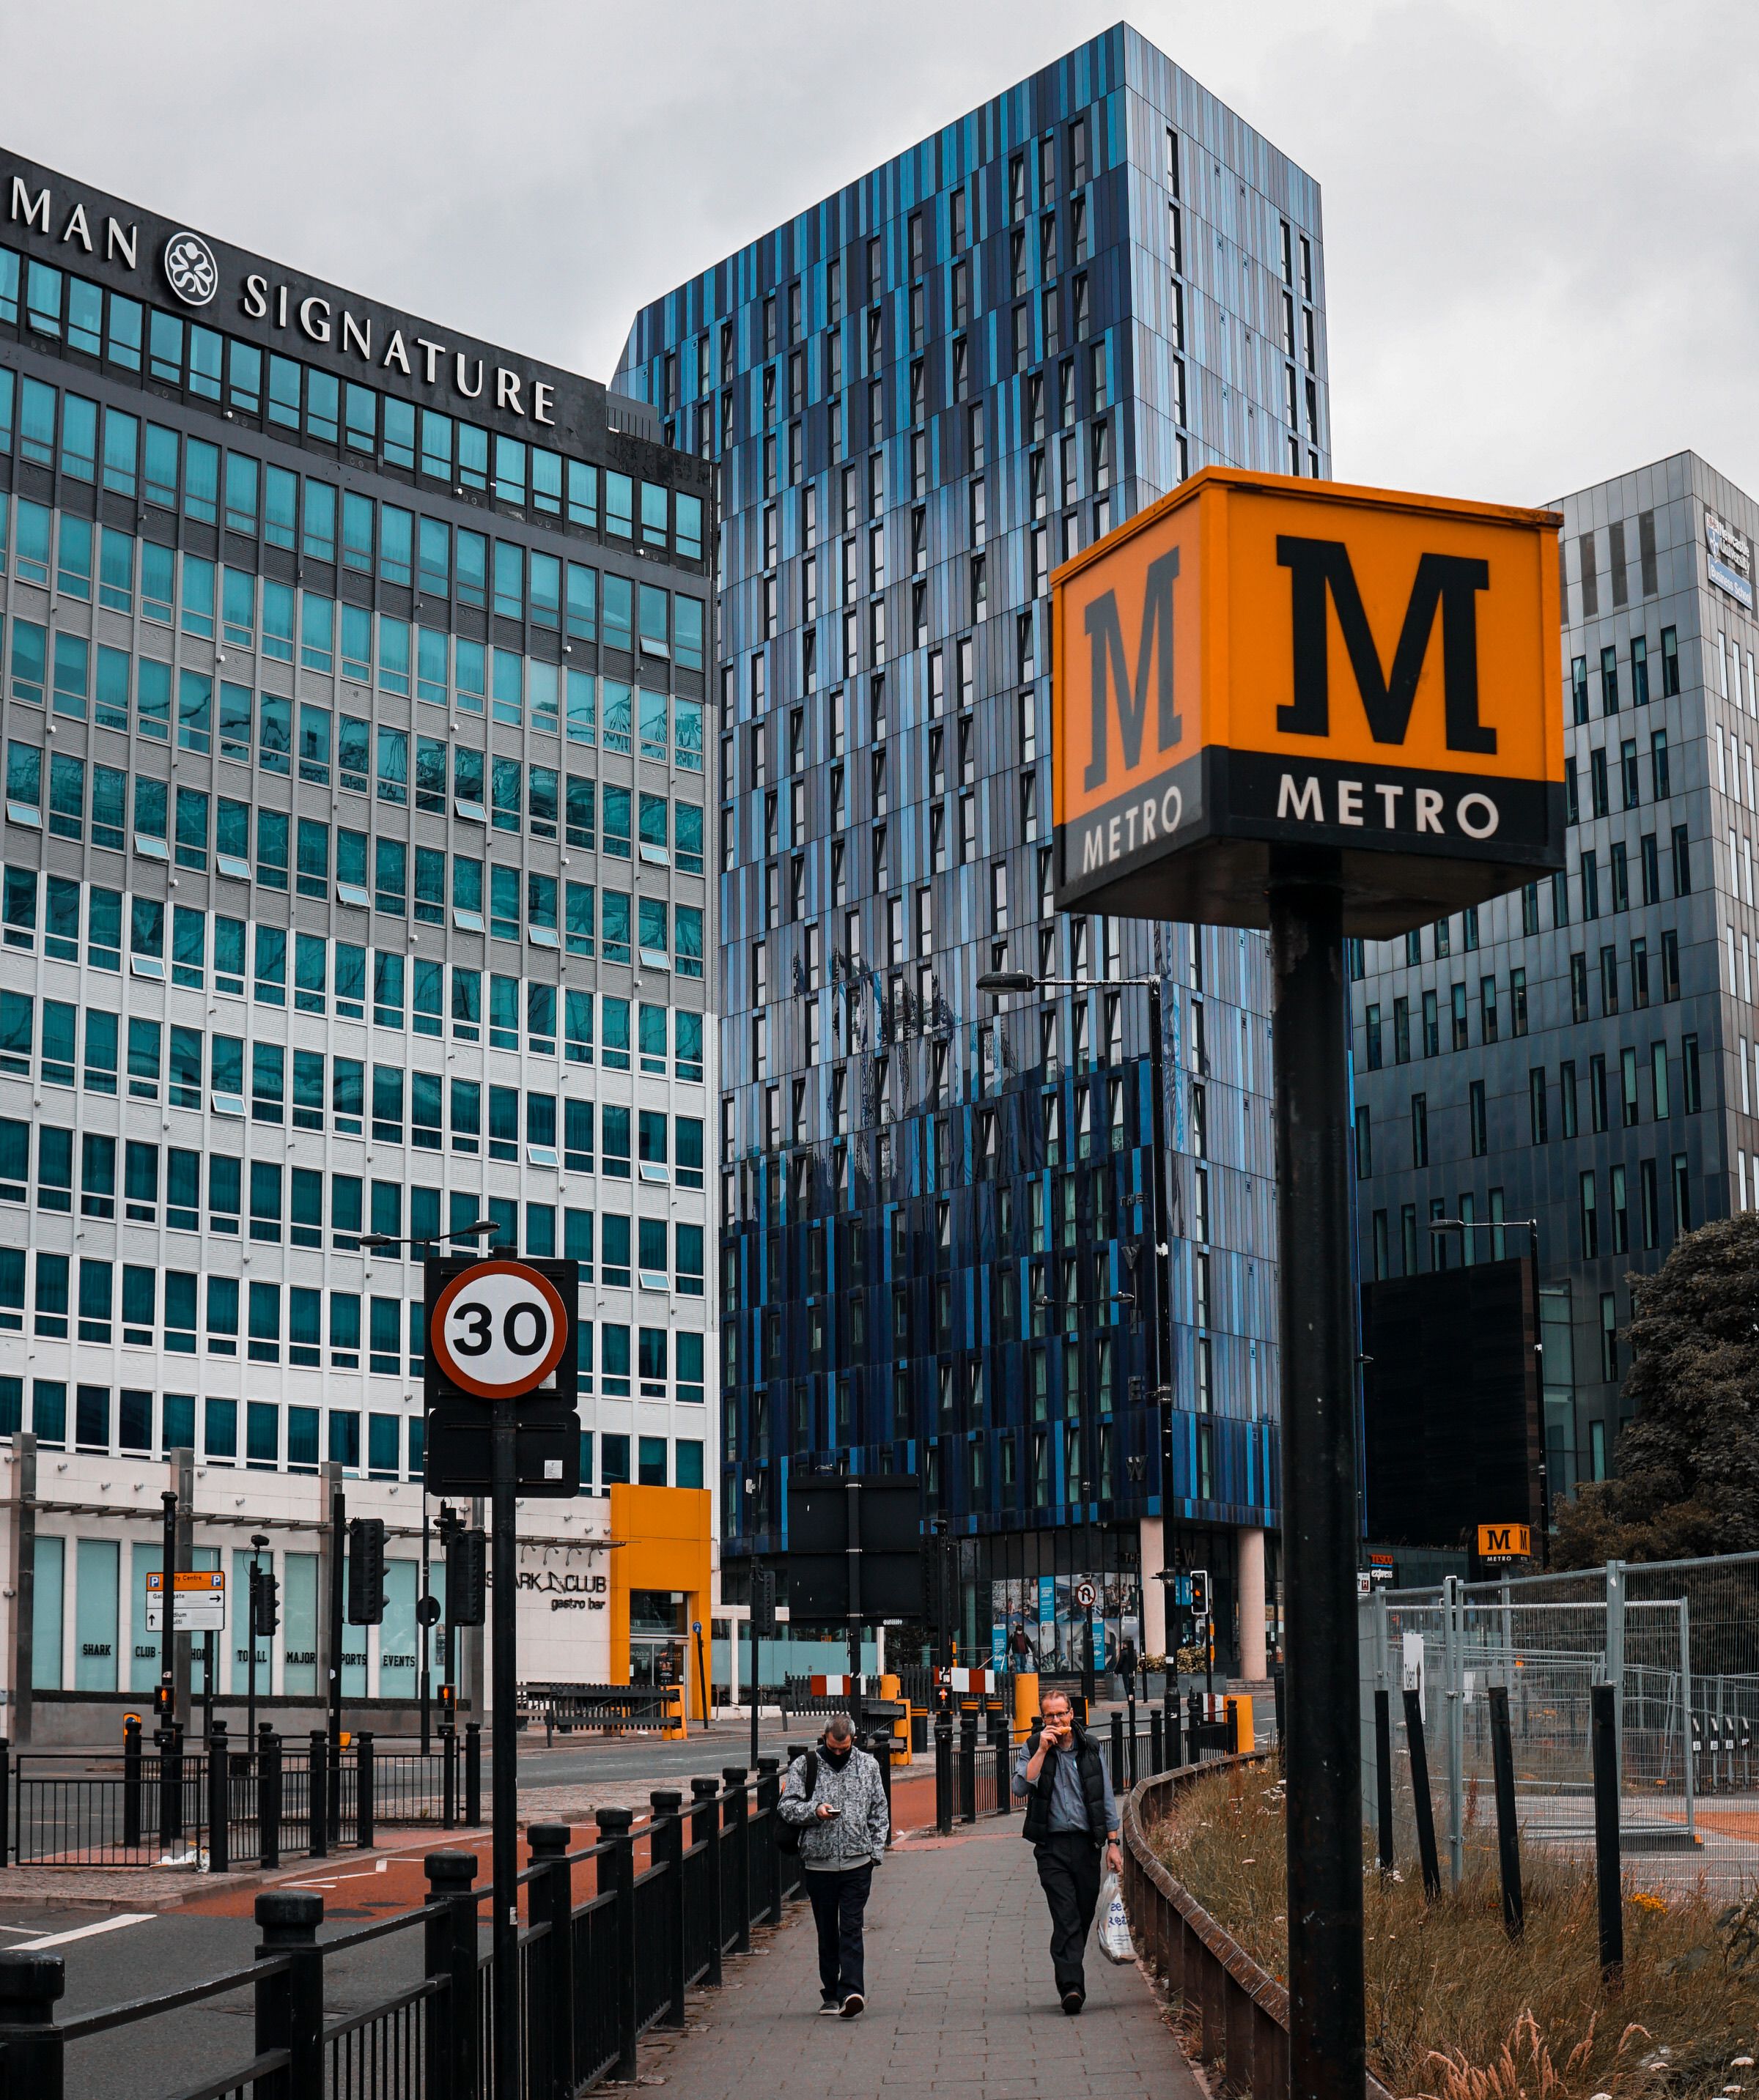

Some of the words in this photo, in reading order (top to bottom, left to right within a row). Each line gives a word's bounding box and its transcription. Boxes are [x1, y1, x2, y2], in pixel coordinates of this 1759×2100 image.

[12, 176, 137, 270] MAN
[244, 274, 556, 426] SIGNATURE
[1719, 522, 1749, 558] Newcastle
[1719, 538, 1750, 577] University
[1711, 563, 1734, 592] Business
[1734, 582, 1752, 604] School
[1276, 534, 1497, 755] M
[1084, 546, 1182, 793] M
[1277, 774, 1499, 839] METRO
[1083, 785, 1182, 874] METRO
[453, 1302, 547, 1356] 30
[1371, 1554, 1393, 1564] TESCO
[1487, 1530, 1511, 1550] M
[566, 1575, 607, 1593] CLUB
[1371, 1569, 1393, 1580] express
[551, 1598, 585, 1611] gastro
[588, 1597, 605, 1610] bar
[83, 1644, 111, 1656] SHARK
[135, 1646, 155, 1658] CLUB
[237, 1650, 248, 1662] TO
[287, 1652, 315, 1664] MAJOR
[341, 1653, 367, 1665] PORTS
[383, 1655, 416, 1668] EVENTS
